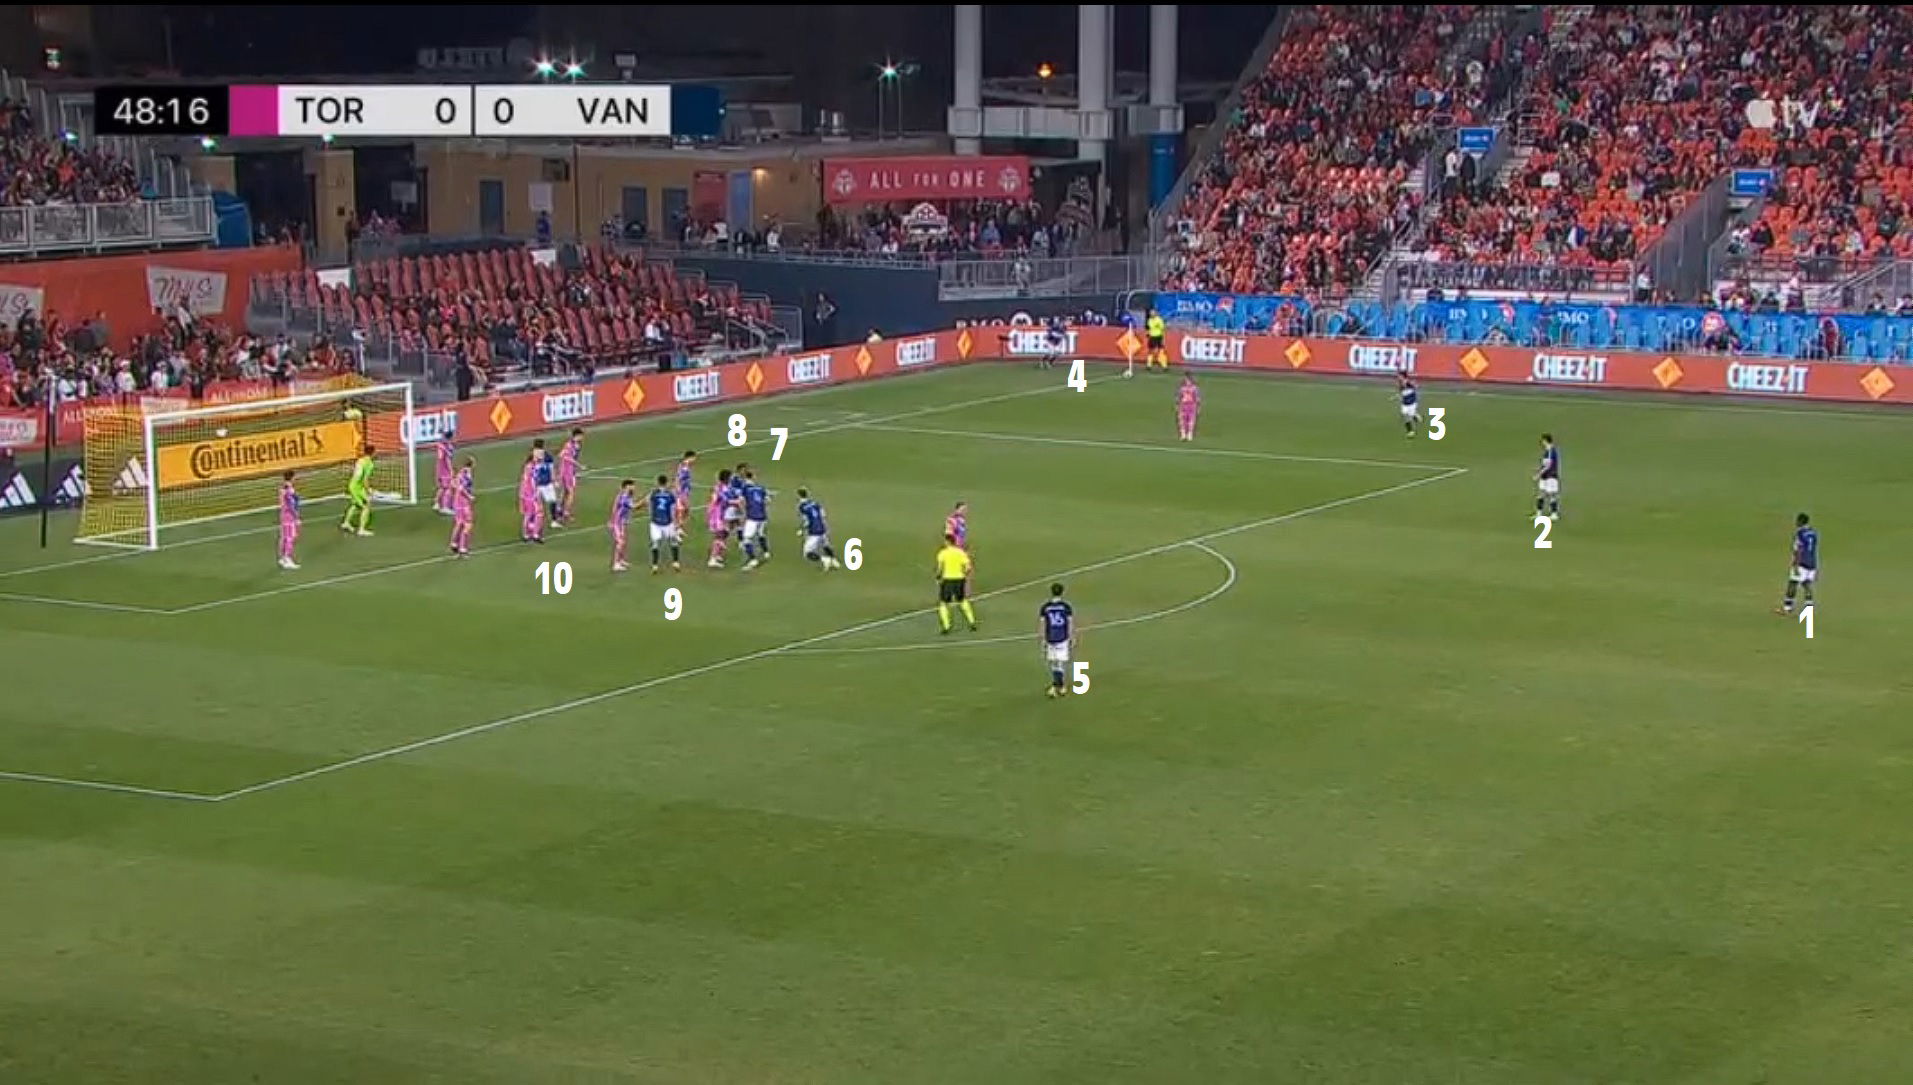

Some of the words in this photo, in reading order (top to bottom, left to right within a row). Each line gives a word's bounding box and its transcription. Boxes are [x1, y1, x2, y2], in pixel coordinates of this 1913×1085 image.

[870, 171, 902, 190] ALL
[948, 169, 985, 188] ONE
[1180, 335, 1247, 363] CHEEZ-IT
[1348, 344, 1418, 373] CHEEZ-IT
[1533, 352, 1608, 382] CHEEZ-IT
[1727, 362, 1809, 393] CHEEZ-IT
[189, 430, 306, 479] Continental
